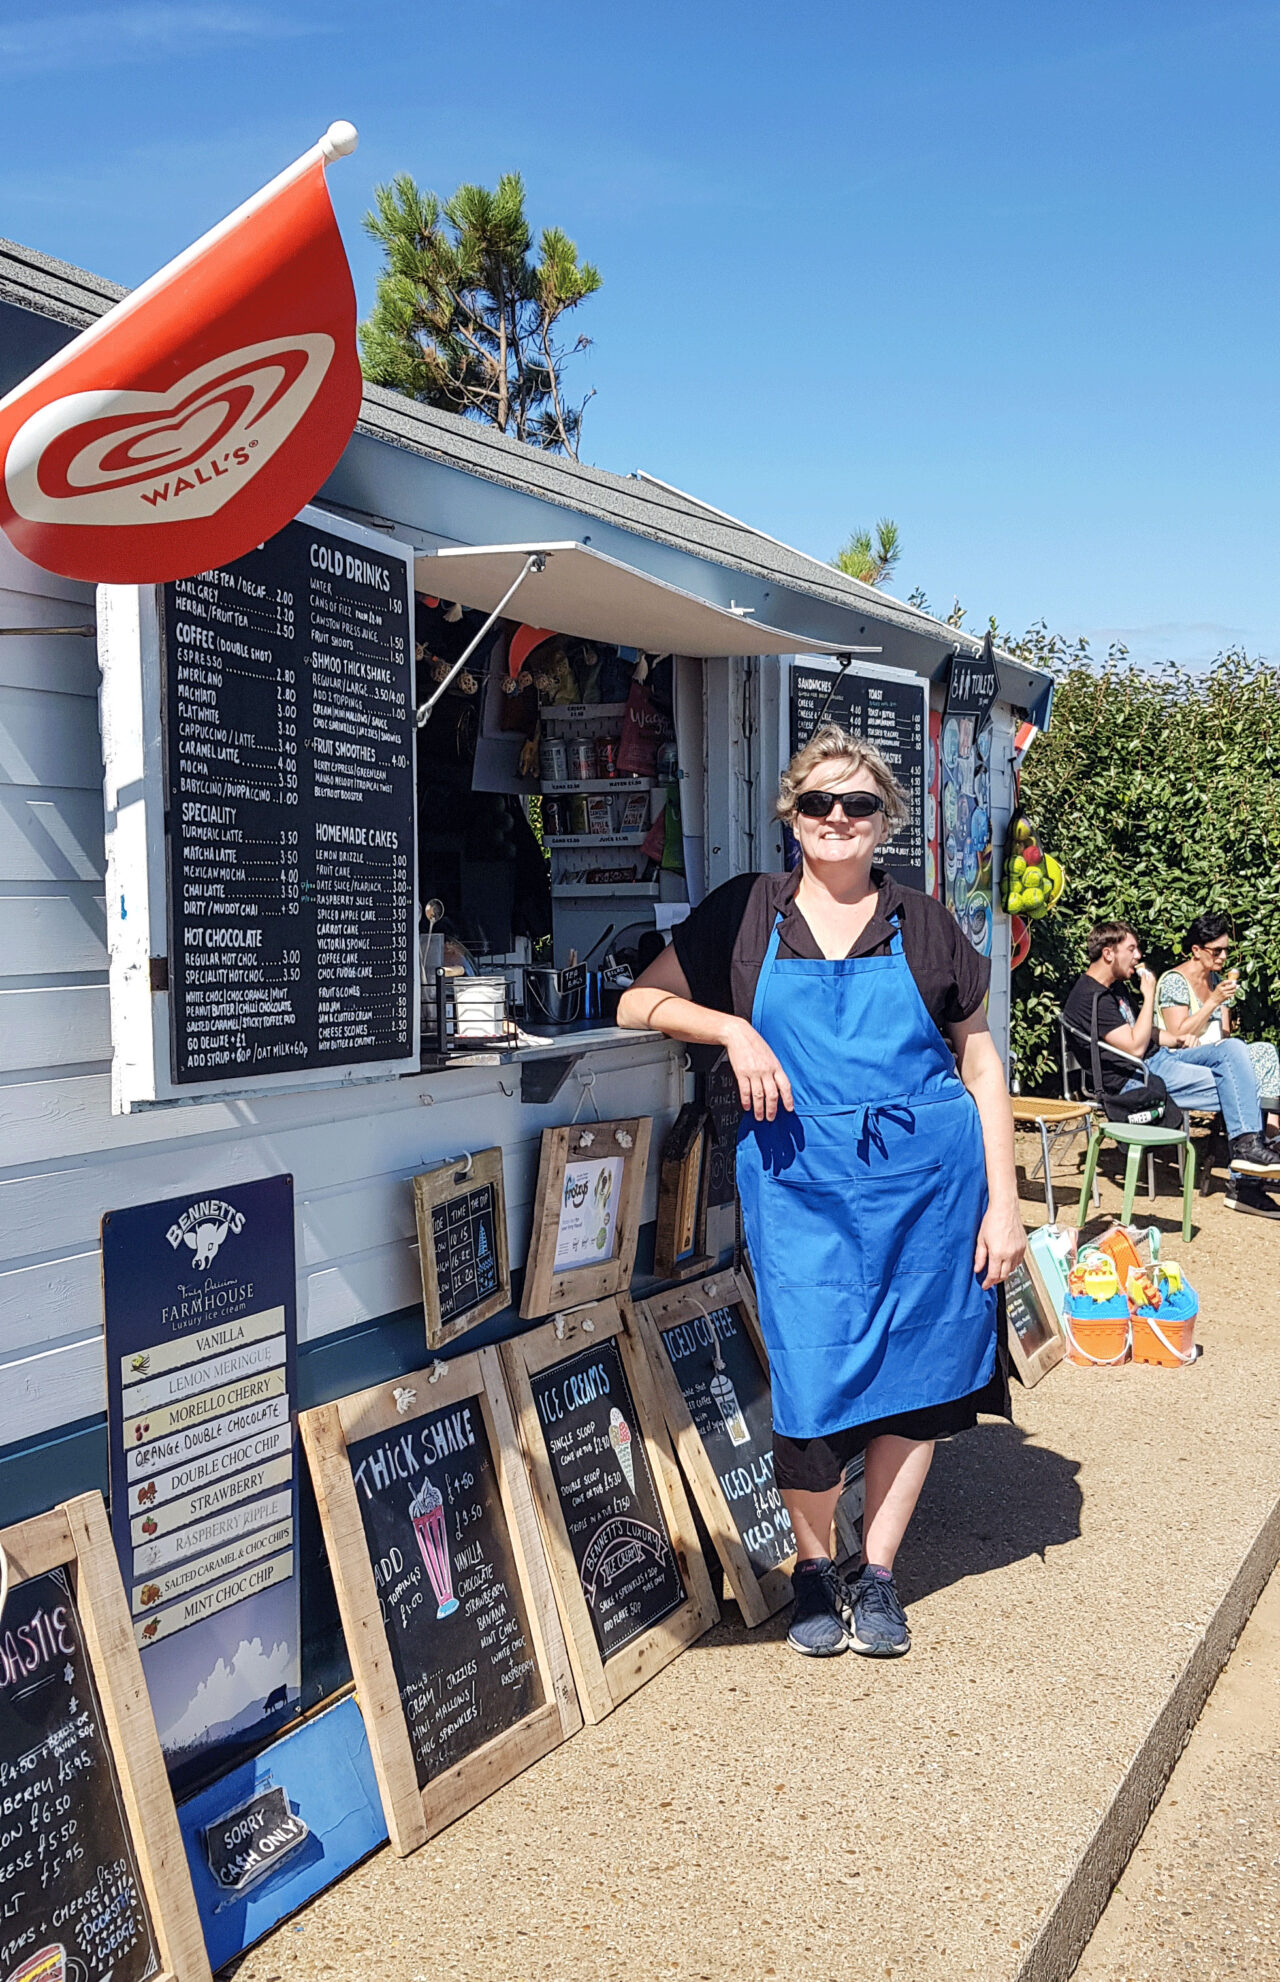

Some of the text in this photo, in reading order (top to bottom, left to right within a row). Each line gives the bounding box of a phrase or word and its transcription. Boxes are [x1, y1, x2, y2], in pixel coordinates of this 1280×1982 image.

[140, 446, 250, 507] WALL'S
[220, 573, 235, 589] TEA
[310, 544, 390, 592] COLD DRINKS
[175, 580, 218, 603] EARL GREY
[276, 589, 293, 605] 2.00
[310, 578, 333, 596] WATER
[310, 595, 352, 618] CANS FIZZ
[176, 622, 215, 649] COFFEE
[311, 612, 360, 638] CAWSTON PRESS
[311, 629, 353, 651] FRUIT SHOOTS
[177, 648, 222, 669] ESPRESSO
[312, 651, 341, 674] SHMOO
[177, 665, 222, 688] AMERICANO
[797, 678, 832, 693] SANDWICHES
[972, 674, 995, 696] TOILETS
[178, 684, 216, 705] MACHIATO
[333, 694, 362, 710] TOPPINGS
[868, 689, 883, 701] TOAST
[277, 704, 297, 718] 3.00
[179, 722, 256, 748] CAPPUCCINO LATTE
[179, 741, 240, 764] CARAMEL LATTE
[313, 737, 376, 762] FRUIT SMOOTHIES
[180, 759, 208, 775] MOCHA
[182, 802, 236, 824] SPECIALITY
[181, 824, 243, 843] TURMERIC LATTE
[280, 831, 298, 845] 3.50
[315, 823, 398, 849] HOMEMADE CAKES
[183, 845, 237, 863] MATCHA LATTE
[315, 849, 364, 863] LEMON DRIZZLE
[183, 865, 246, 881] MEXICAN MOCHA
[334, 866, 351, 878] CAKE
[183, 883, 226, 898] CHAI LATTE
[281, 884, 299, 898] 3.50
[316, 894, 353, 906] RASPBERRY
[184, 901, 258, 917] DIRTY CHAI
[317, 909, 376, 921] SPICED APPLE CAKE
[184, 927, 263, 948] HOT CHOCOLATE
[316, 923, 359, 936] CARROT CAKE
[317, 937, 370, 950] VICTORIA SPONGE
[185, 952, 257, 966] REGULAR HOT CHOC
[283, 950, 300, 964] 3.00
[317, 952, 358, 965] COFFEE CAKE
[185, 968, 228, 984] SPECIALITY
[283, 967, 300, 981] 3.50
[318, 966, 356, 980] CHOC FUDGE
[335, 985, 360, 998] SCONES
[200, 1034, 229, 1049] DELUXE
[318, 1024, 368, 1039] CHEESE SCONES
[165, 1199, 247, 1250] BENNETTS
[451, 1204, 467, 1222] TIME
[161, 1282, 254, 1325] FARMHOUSE
[172, 1303, 247, 1331] Luxury cream
[196, 1325, 246, 1353] VANILLA
[662, 1324, 697, 1363] ICED
[169, 1346, 273, 1394] LEMON MERINGUE
[169, 1378, 272, 1426] MORELLO CHERRY
[539, 1363, 610, 1425] ICE CREAMS
[135, 1403, 281, 1468] ORANGE DOUBLE CHOCOLATE
[550, 1421, 596, 1454] SINGLE SCOOP
[171, 1434, 281, 1491] DOUBLE CHOC CHIP
[354, 1408, 477, 1500] THICK SHAKE
[560, 1468, 600, 1497] DOUBLE SCOOP
[720, 1450, 774, 1501] ICED LAT
[190, 1471, 266, 1514] STRAWBERRY
[175, 1501, 280, 1552] RASPBERRY RIPPLE
[626, 1522, 660, 1550] LUXURY
[743, 1520, 775, 1553] ICED
[164, 1569, 197, 1592] SALTED
[197, 1551, 238, 1577] CARAMEL
[238, 1547, 245, 1560] &
[245, 1535, 268, 1555] CHOC
[374, 1547, 403, 1590] ADD
[454, 1540, 484, 1573] VANILLA
[184, 1566, 275, 1621] MINT CHOC CHIP
[387, 1566, 421, 1607] TOPPINGS
[457, 1563, 494, 1598] CHOCOLATE
[464, 1582, 508, 1617] STRAWBERRY
[476, 1602, 507, 1632] BANANA
[480, 1618, 518, 1649] MINT CHOC
[491, 1635, 527, 1665] WHITE CHOC
[500, 1659, 536, 1687] RASPBERRY
[407, 1659, 478, 1721] CREAM JAZZIES
[416, 1704, 479, 1763] CHOC SPRINKLES
[0, 1776, 54, 1818] BERRY
[30, 1794, 71, 1833] £6.50
[37, 1819, 78, 1860] £5.50
[223, 1807, 265, 1850] SORRY
[258, 1818, 299, 1854] ONLY
[52, 1885, 100, 1928] CHEESE
[83, 1886, 131, 1941] DOORSTEP
[97, 1917, 137, 1959] WEDGE
